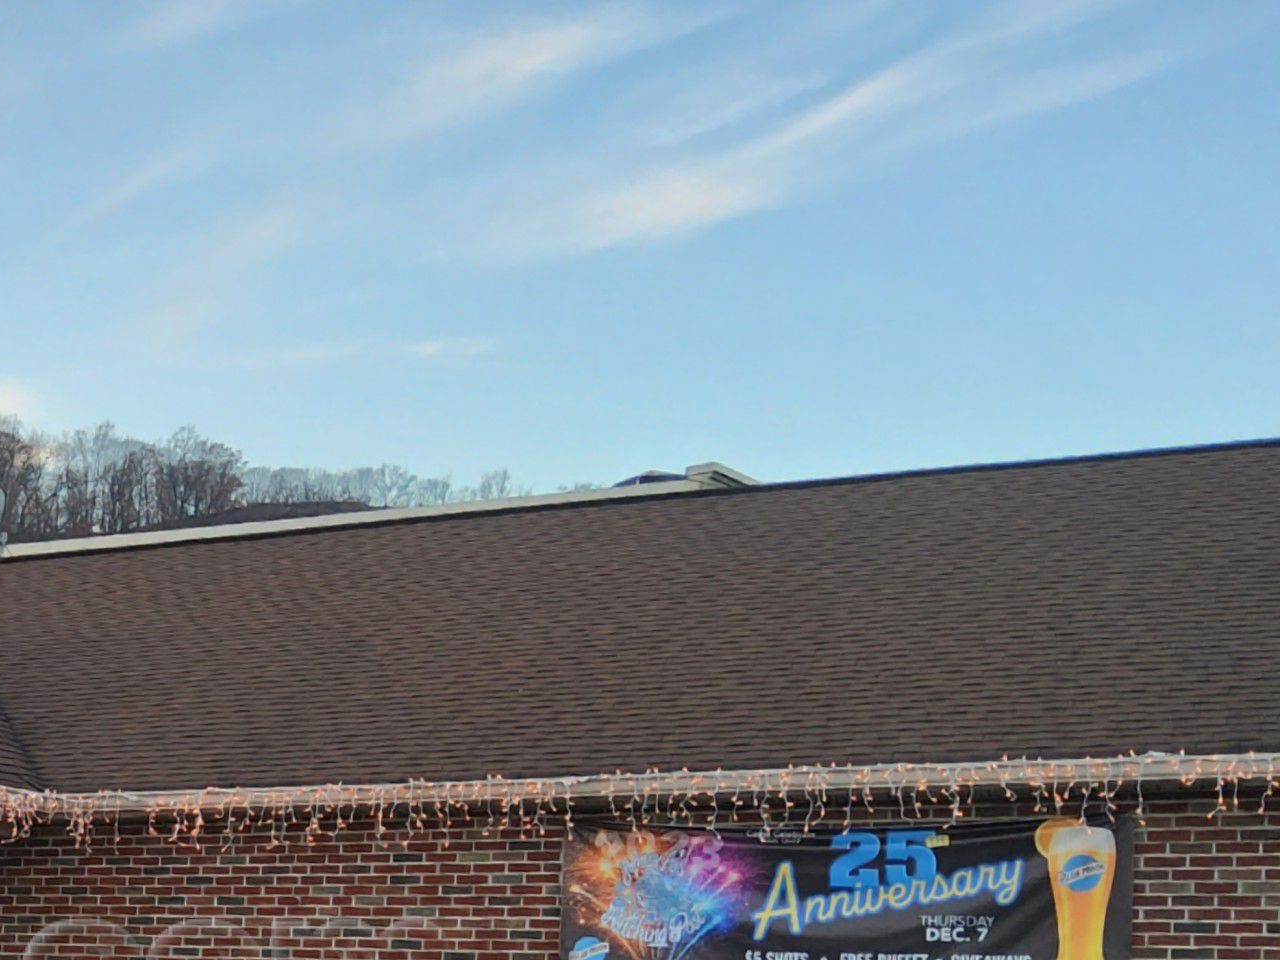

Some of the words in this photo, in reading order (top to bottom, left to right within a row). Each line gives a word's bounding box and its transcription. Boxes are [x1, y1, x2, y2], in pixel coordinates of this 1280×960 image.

[829, 830, 937, 891] 25
[750, 857, 1024, 941] Anniversary
[919, 914, 995, 927] THURSDAY
[925, 927, 971, 942] DEC.
[976, 927, 989, 942] 7
